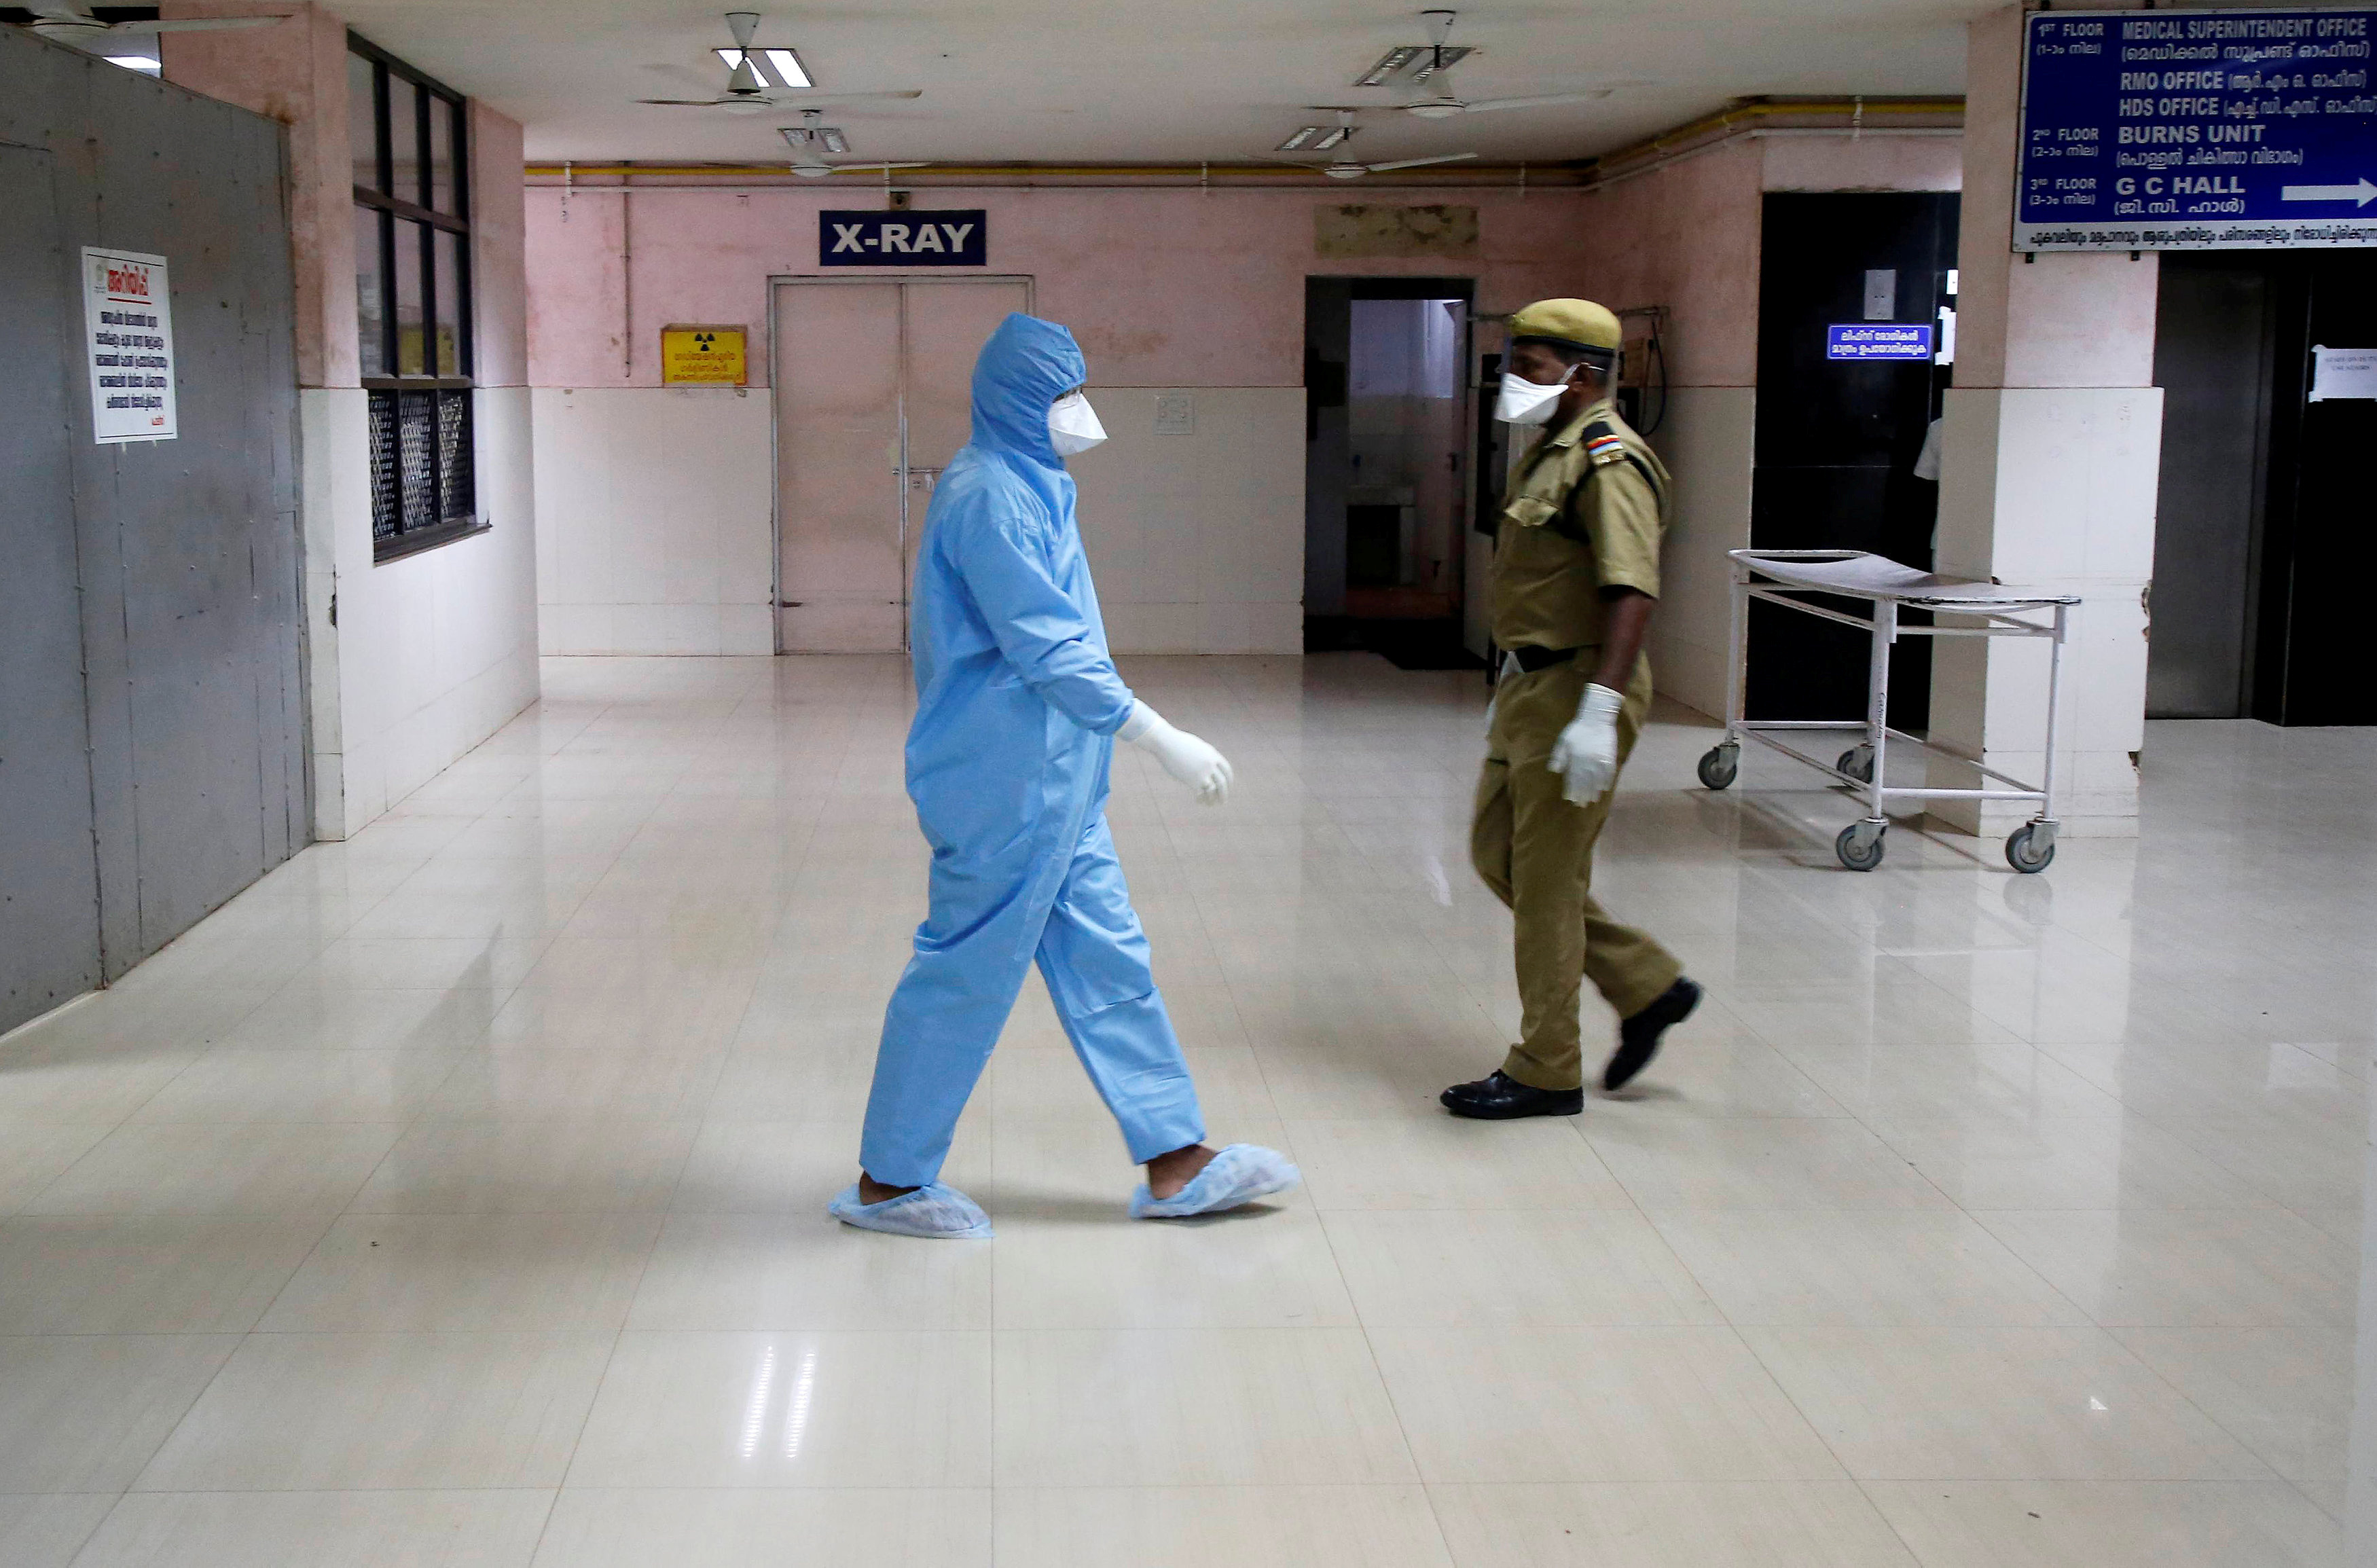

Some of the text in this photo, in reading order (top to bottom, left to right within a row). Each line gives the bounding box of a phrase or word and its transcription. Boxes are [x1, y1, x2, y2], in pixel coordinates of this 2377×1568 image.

[2062, 23, 2104, 37] FLOOR
[2122, 18, 2367, 39] MEDICAL SUPERINTENDENT OFFICE
[2120, 71, 2158, 90] RMO
[2163, 70, 2224, 90] OFFICE
[2119, 98, 2154, 115] HDS
[2159, 97, 2219, 115] OFFICE
[2058, 128, 2099, 141] FLOOR
[2118, 124, 2266, 144] BURNS UNIT
[2055, 178, 2097, 190] FLOOR
[2116, 176, 2246, 195] G C HALL
[831, 224, 975, 253] X-RAY
